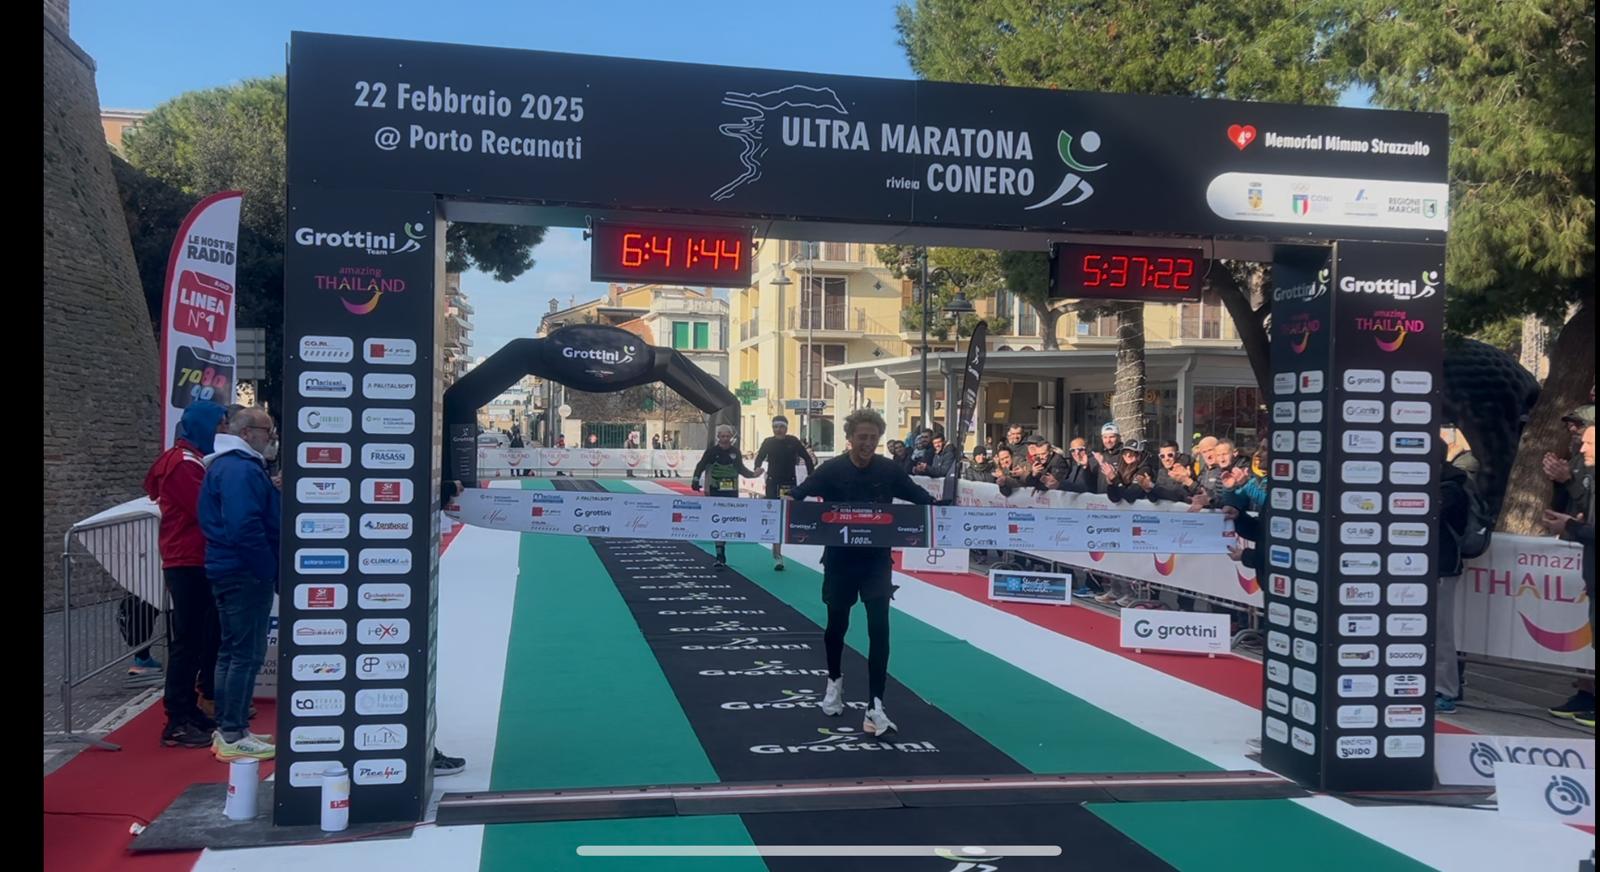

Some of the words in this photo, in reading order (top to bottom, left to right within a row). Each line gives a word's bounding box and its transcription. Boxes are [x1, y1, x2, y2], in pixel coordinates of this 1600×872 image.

[355, 81, 387, 108] 22
[397, 83, 511, 117] Febbraio
[521, 93, 584, 122] 2025
[374, 126, 401, 151] @
[409, 125, 473, 153] Porto
[481, 130, 582, 160] Recanati
[782, 116, 870, 151] ULTRA
[881, 123, 1034, 161] MARATONA
[1265, 132, 1322, 150] Memorial
[1325, 136, 1369, 153] Mimmo
[1371, 138, 1430, 156] Strazzullo
[926, 163, 1035, 196] CONERO
[1388, 197, 1421, 206] REGIONE
[1388, 205, 1420, 214] MARCHE
[189, 235, 199, 245] LE
[201, 237, 235, 251] NOSTRE
[295, 227, 395, 249] Grottini
[187, 245, 235, 266] RADIO
[622, 233, 740, 270] 6:41:44
[339, 266, 382, 278] amazing
[1083, 255, 1193, 289] 5:37:22
[314, 275, 405, 292] THAILAND
[1340, 276, 1416, 295] Grottini
[180, 288, 226, 316] LINEA
[1373, 309, 1406, 319] amazing
[1355, 318, 1425, 333] THAILAND
[562, 347, 619, 361] Grottini
[371, 452, 405, 461] FRASASSI
[585, 509, 611, 517] grottini
[721, 515, 747, 523] grottini
[840, 526, 848, 544] 1
[1096, 526, 1120, 534] grottini
[1518, 552, 1581, 570] amazi
[1468, 567, 1588, 603] THAIL
[1158, 624, 1216, 640] grottini
[681, 643, 812, 651] Grottini
[1389, 651, 1424, 660] saucony
[299, 661, 341, 672] graphos
[699, 667, 830, 676] Grottin
[750, 741, 937, 754] Grottini
